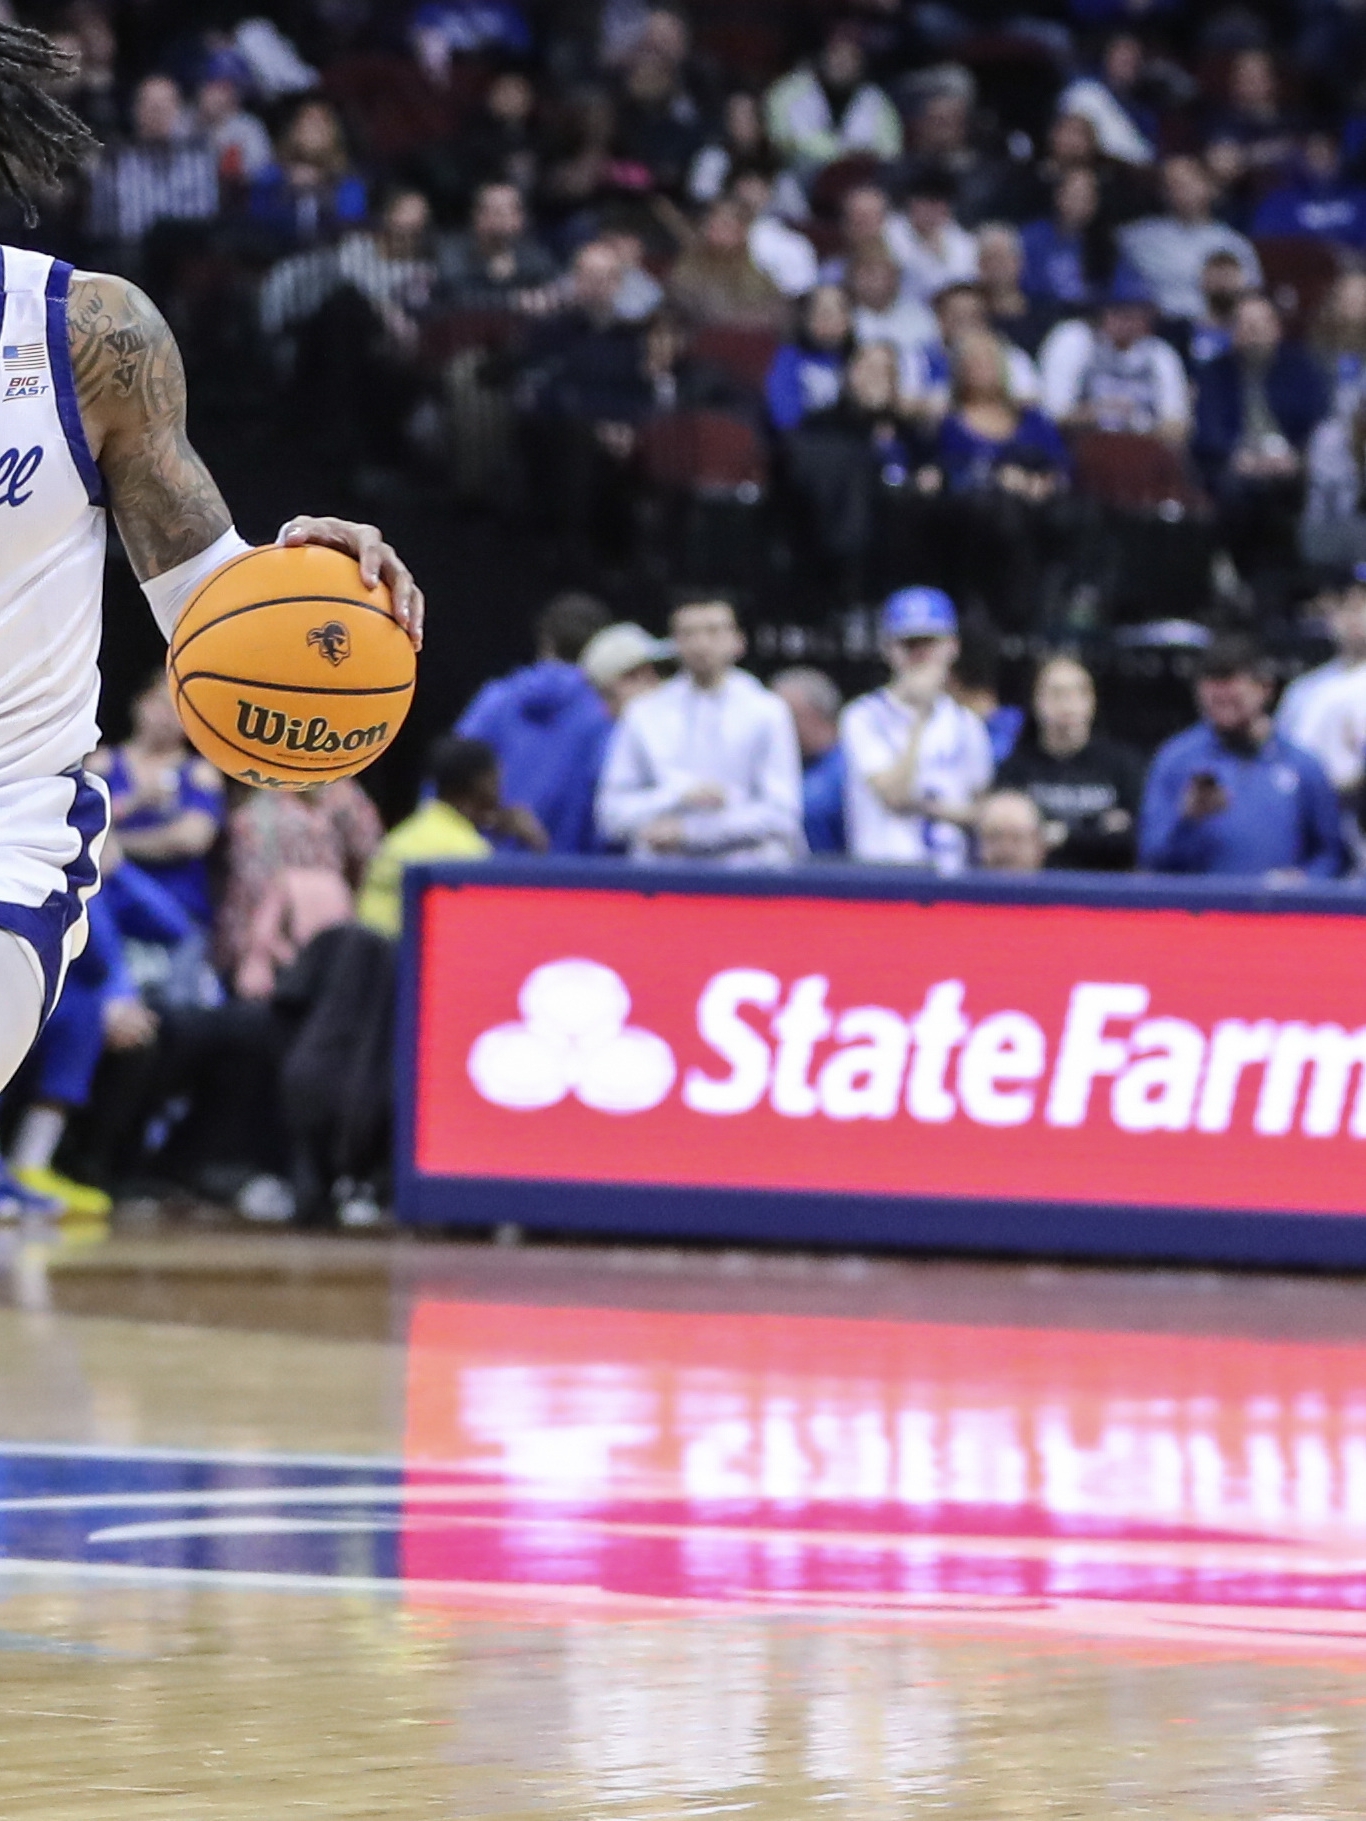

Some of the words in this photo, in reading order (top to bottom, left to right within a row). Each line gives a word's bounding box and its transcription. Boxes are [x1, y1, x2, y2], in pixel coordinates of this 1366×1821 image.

[9, 376, 39, 387] BIG
[5, 385, 49, 397] EAST
[236, 699, 389, 753] Wilson
